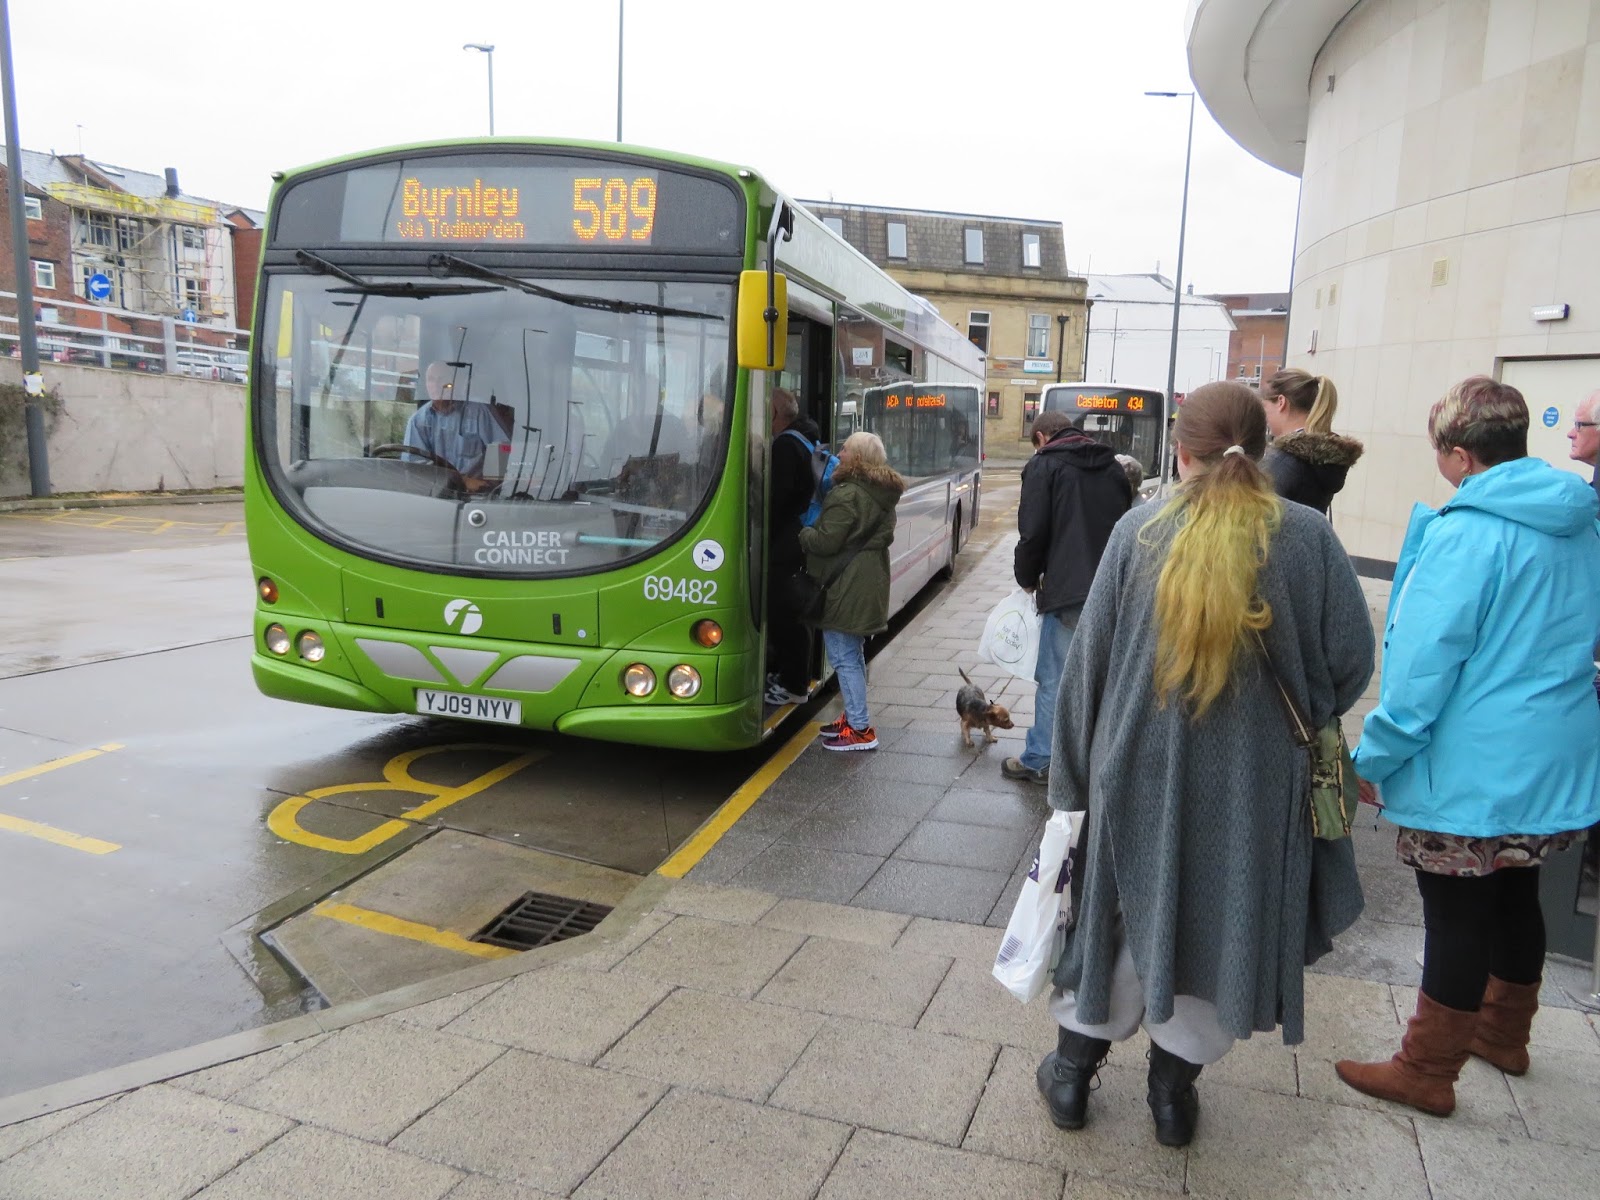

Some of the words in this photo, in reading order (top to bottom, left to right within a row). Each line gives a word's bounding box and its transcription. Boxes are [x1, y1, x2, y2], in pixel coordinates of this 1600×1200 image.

[403, 177, 520, 218] Burnley
[573, 177, 656, 240] 589
[397, 219, 424, 239] via
[428, 219, 525, 239] Todmorden
[1076, 394, 1118, 410] Castleton
[1127, 395, 1144, 411] 434
[483, 531, 561, 547] CALDER
[474, 548, 569, 565] CONNECT
[643, 575, 718, 604] 69482
[425, 692, 471, 715] YJ09
[477, 698, 513, 720] NYV
